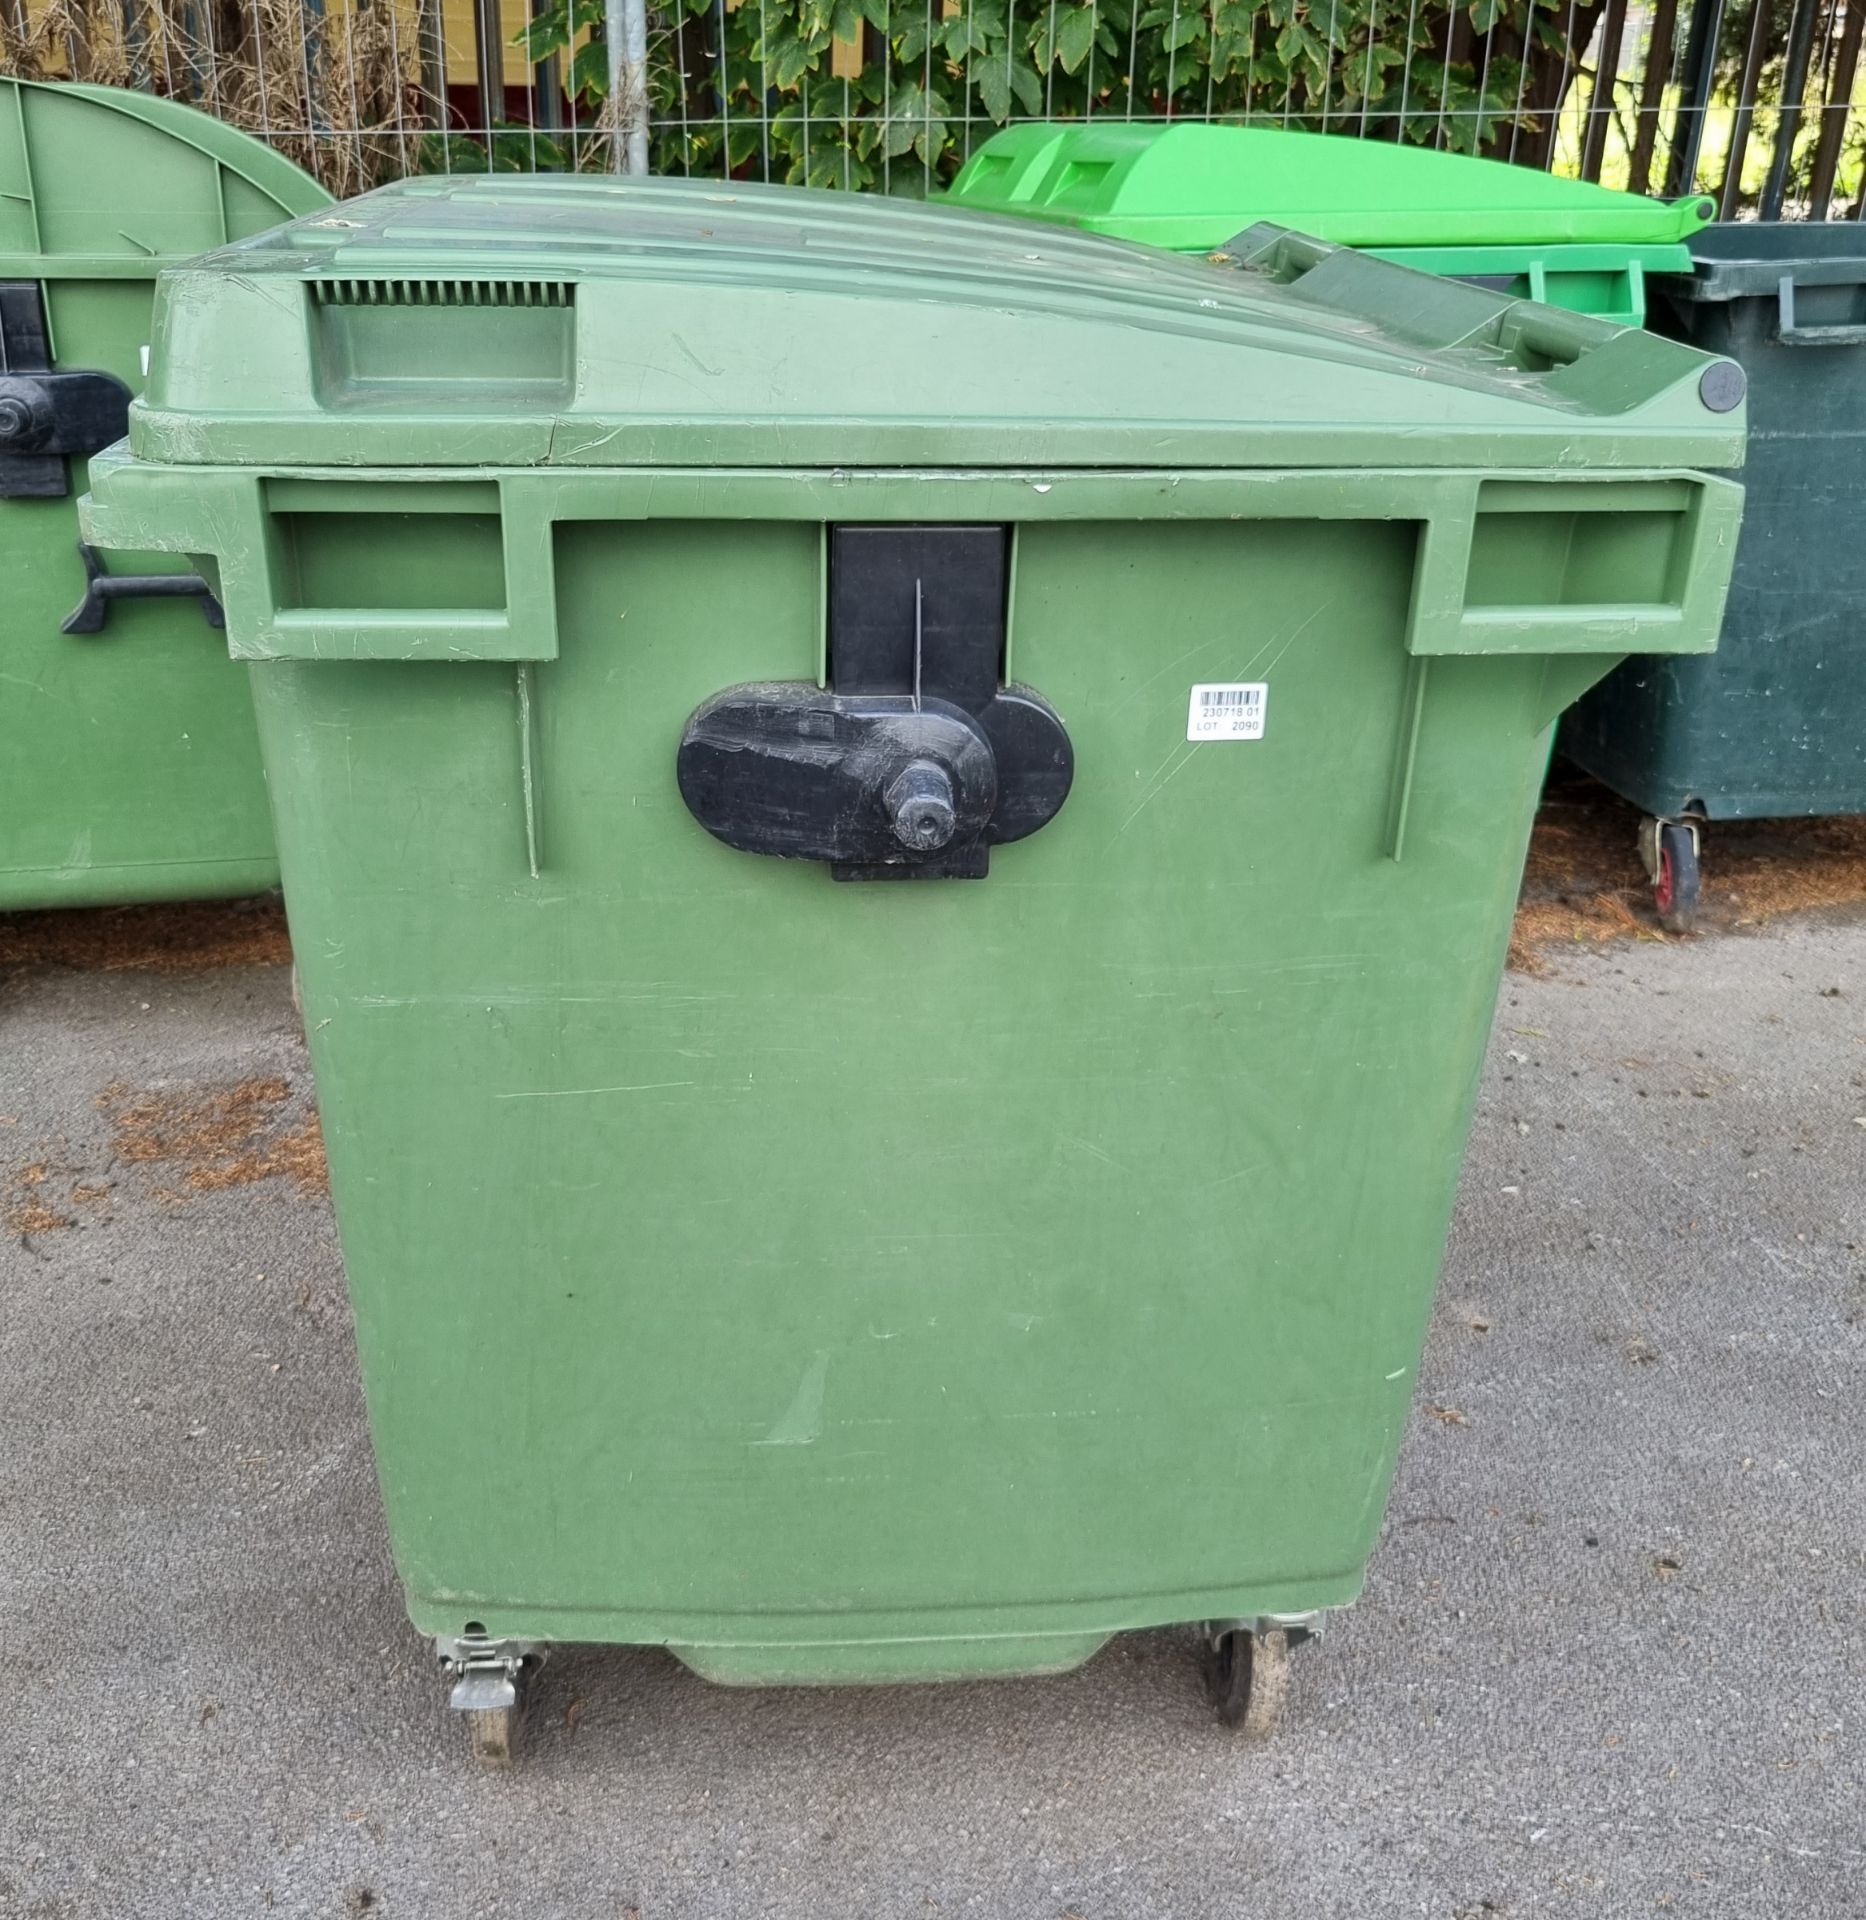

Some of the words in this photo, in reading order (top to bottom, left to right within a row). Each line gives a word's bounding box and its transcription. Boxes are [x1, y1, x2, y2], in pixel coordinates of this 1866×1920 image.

[1202, 707, 1243, 717] 230718
[1246, 707, 1259, 717] 01
[1232, 721, 1259, 731] 2090
